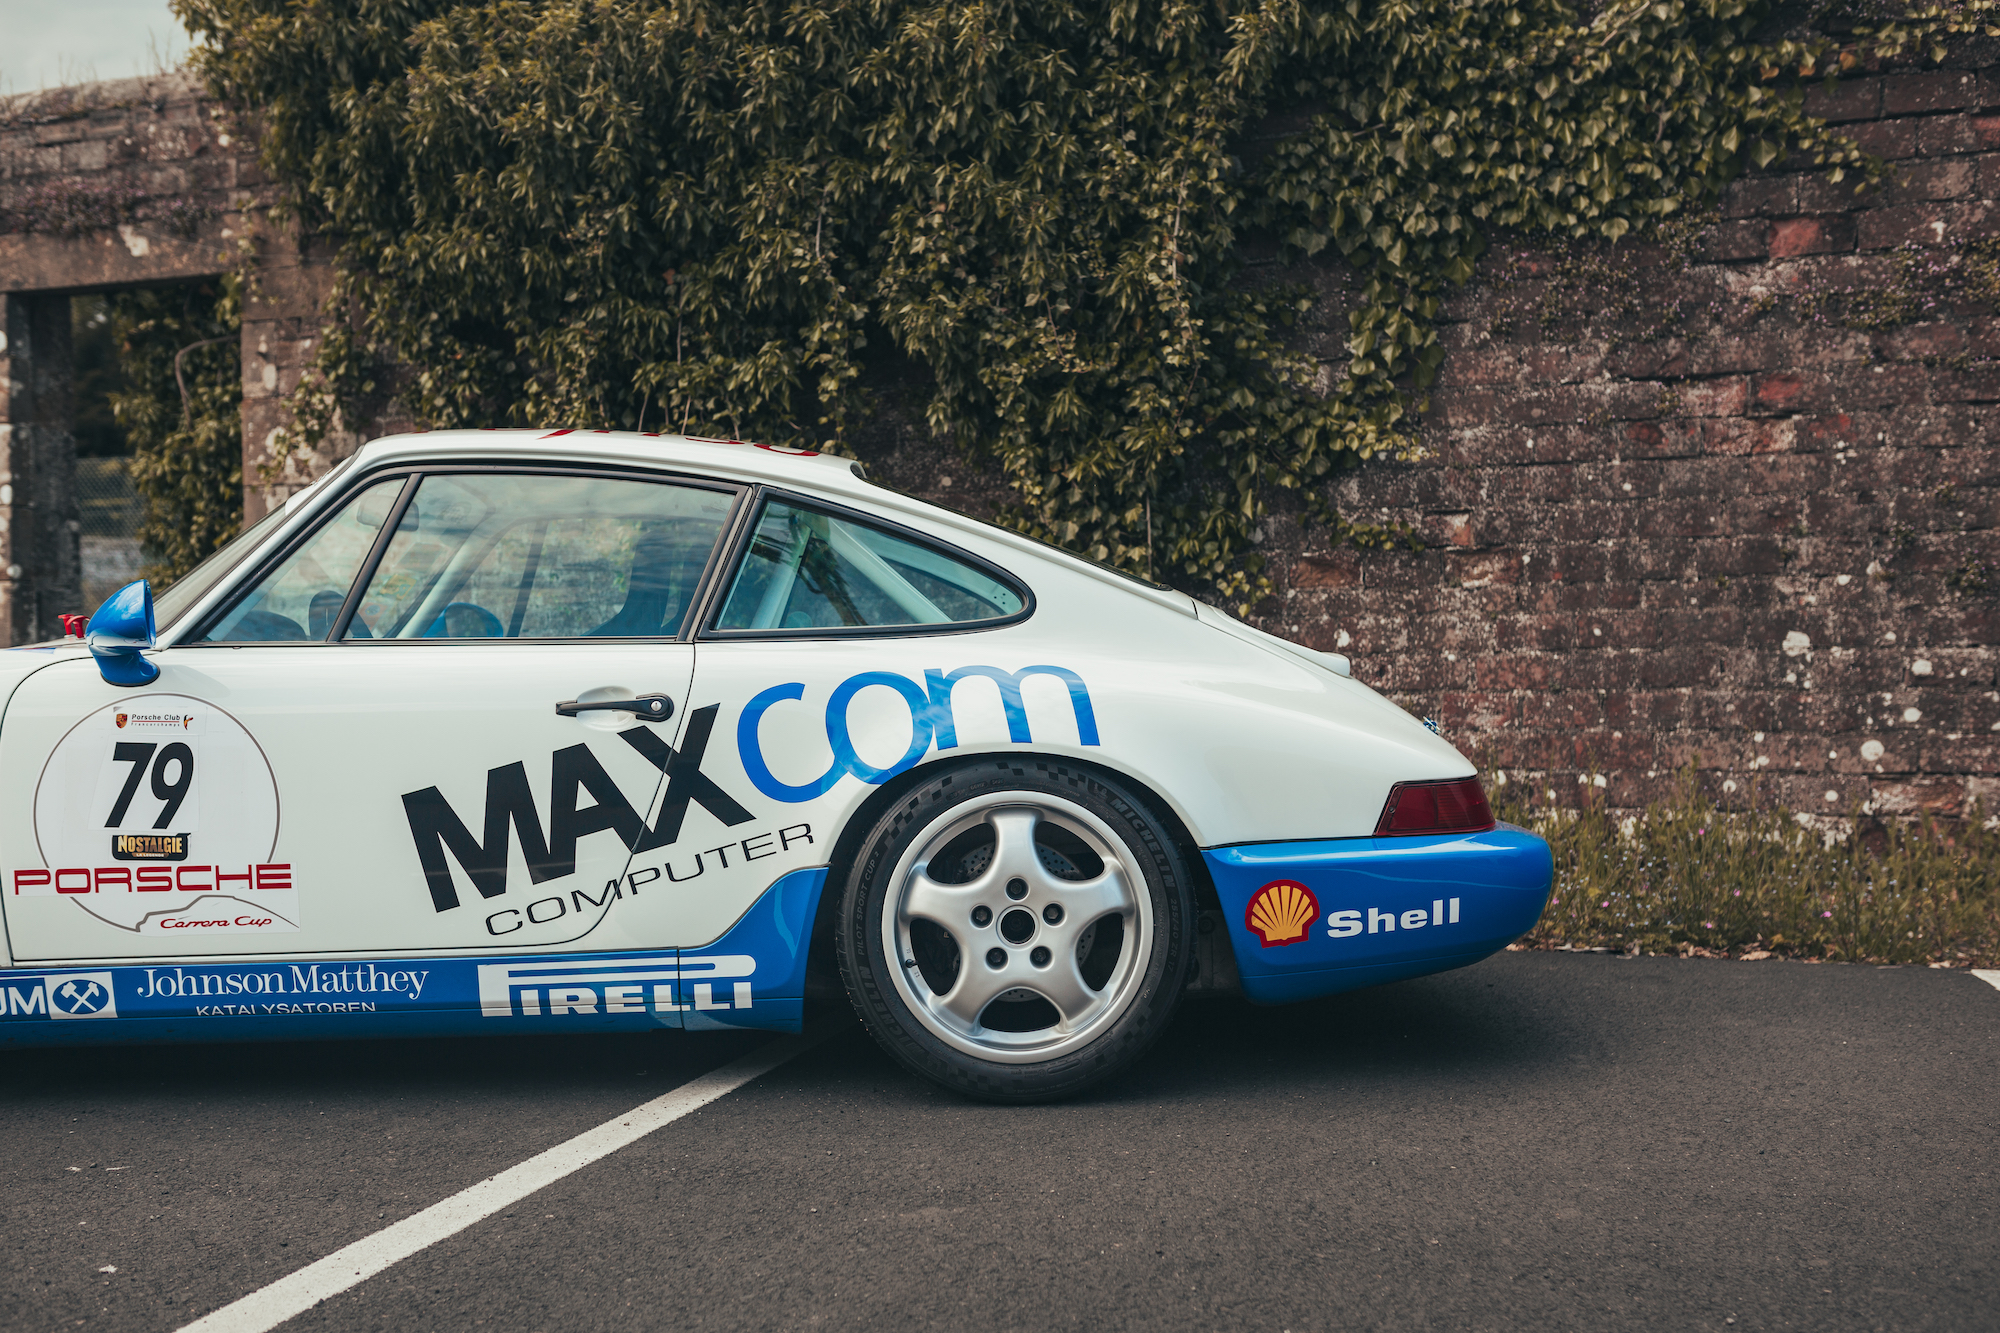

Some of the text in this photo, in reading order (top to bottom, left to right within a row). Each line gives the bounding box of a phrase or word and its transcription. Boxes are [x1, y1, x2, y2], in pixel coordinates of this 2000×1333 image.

[736, 664, 1101, 803] com
[104, 741, 194, 829] 79
[401, 703, 757, 913] MAX
[1110, 798, 1176, 888] MICHELIN
[14, 864, 292, 895] PORSCHE
[485, 823, 814, 936] COMPUTER
[864, 859, 876, 881] CUP
[857, 883, 868, 920] SPORT
[1327, 897, 1460, 938] Shell
[160, 916, 272, 929] Carrera Cup
[856, 924, 865, 956] PILOT
[0, 986, 46, 1016] M
[137, 964, 429, 1000] Johnson Matthey
[477, 955, 756, 1017] PIRELLI
